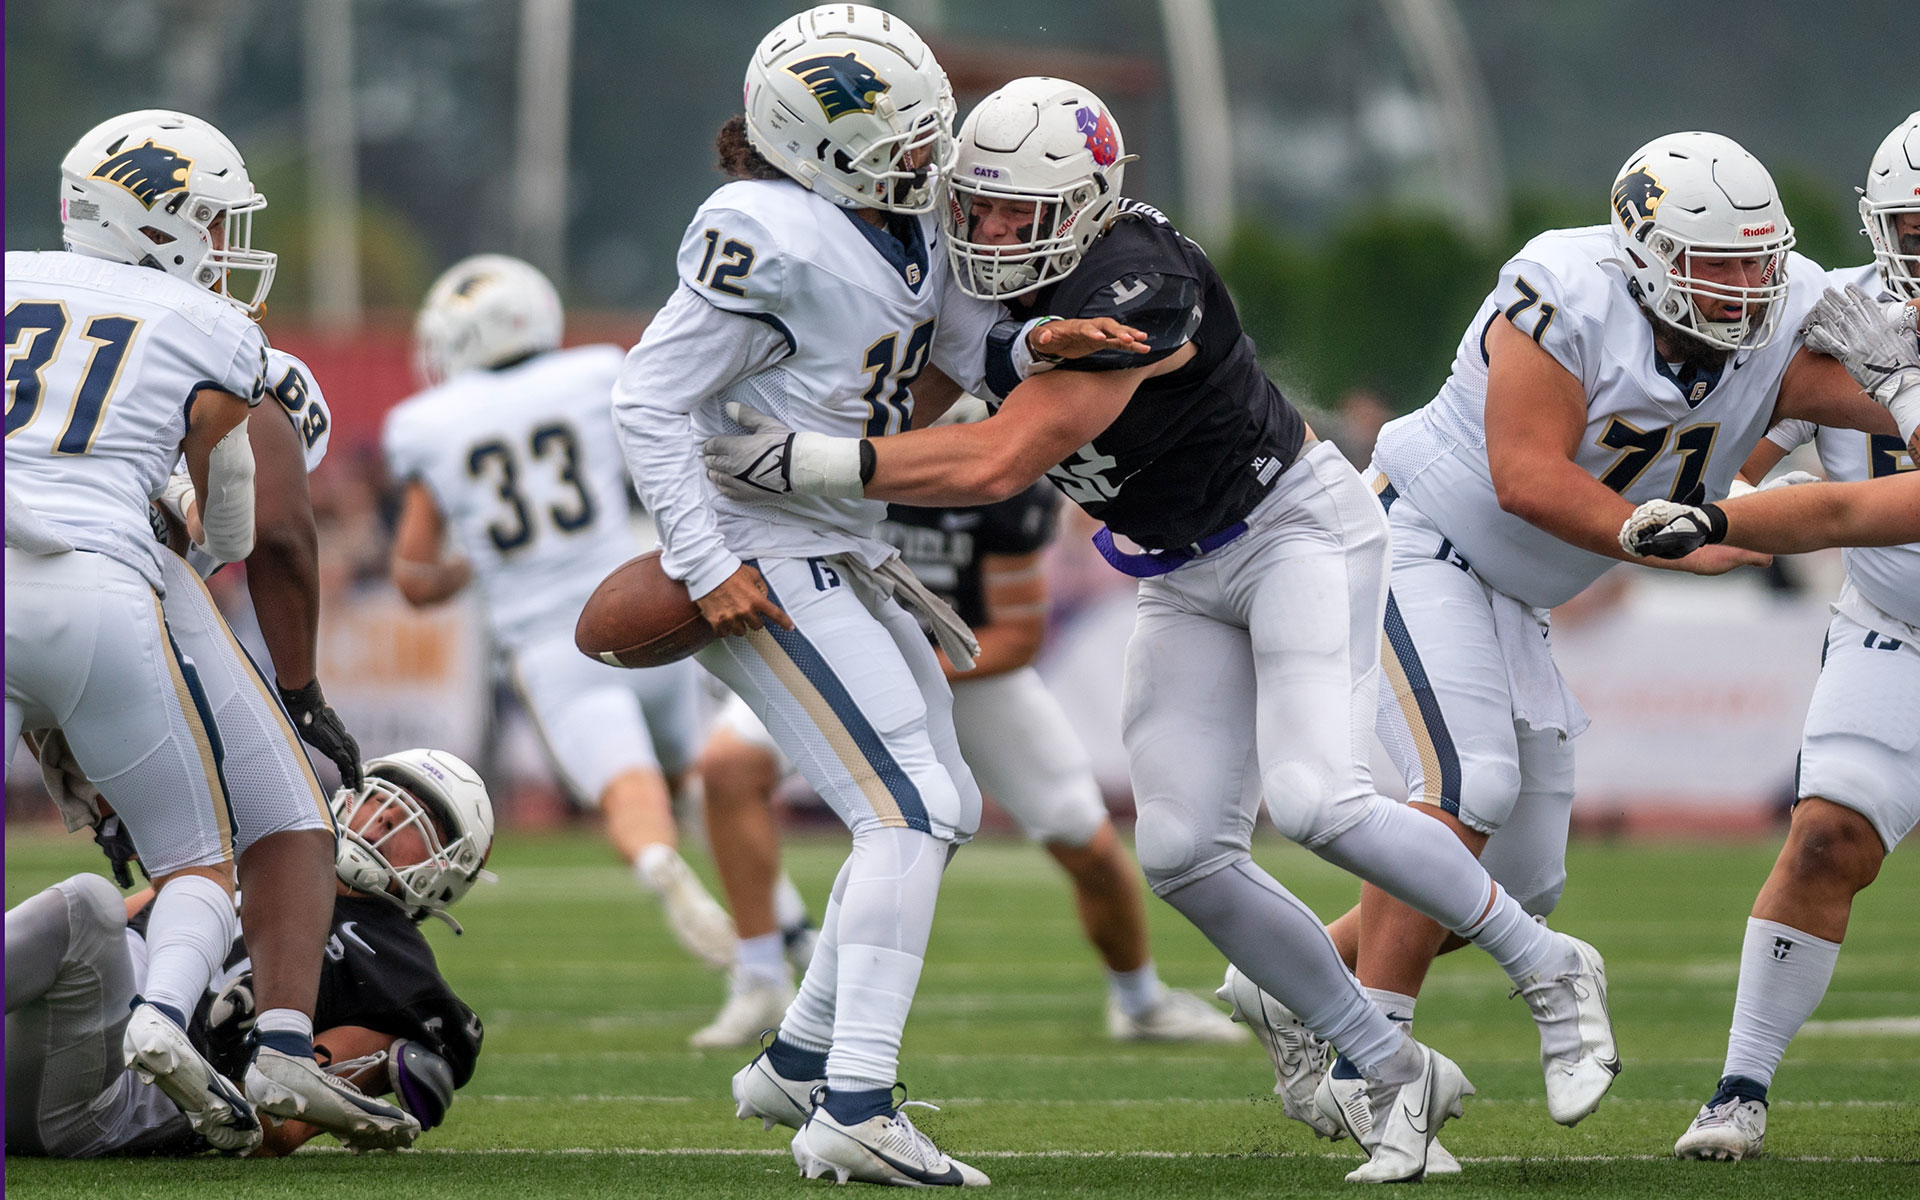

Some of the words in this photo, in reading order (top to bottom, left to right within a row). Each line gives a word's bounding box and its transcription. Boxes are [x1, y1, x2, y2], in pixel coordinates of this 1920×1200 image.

[973, 166, 999, 179] CATS
[695, 228, 757, 299] 12
[1743, 223, 1776, 237] Riddell
[1503, 273, 1558, 347] 71
[5, 299, 146, 456] 31
[272, 364, 329, 452] 69
[466, 418, 600, 556] 33
[1250, 456, 1268, 471] XL
[1595, 413, 1720, 502] 71
[421, 762, 446, 780] CATS
